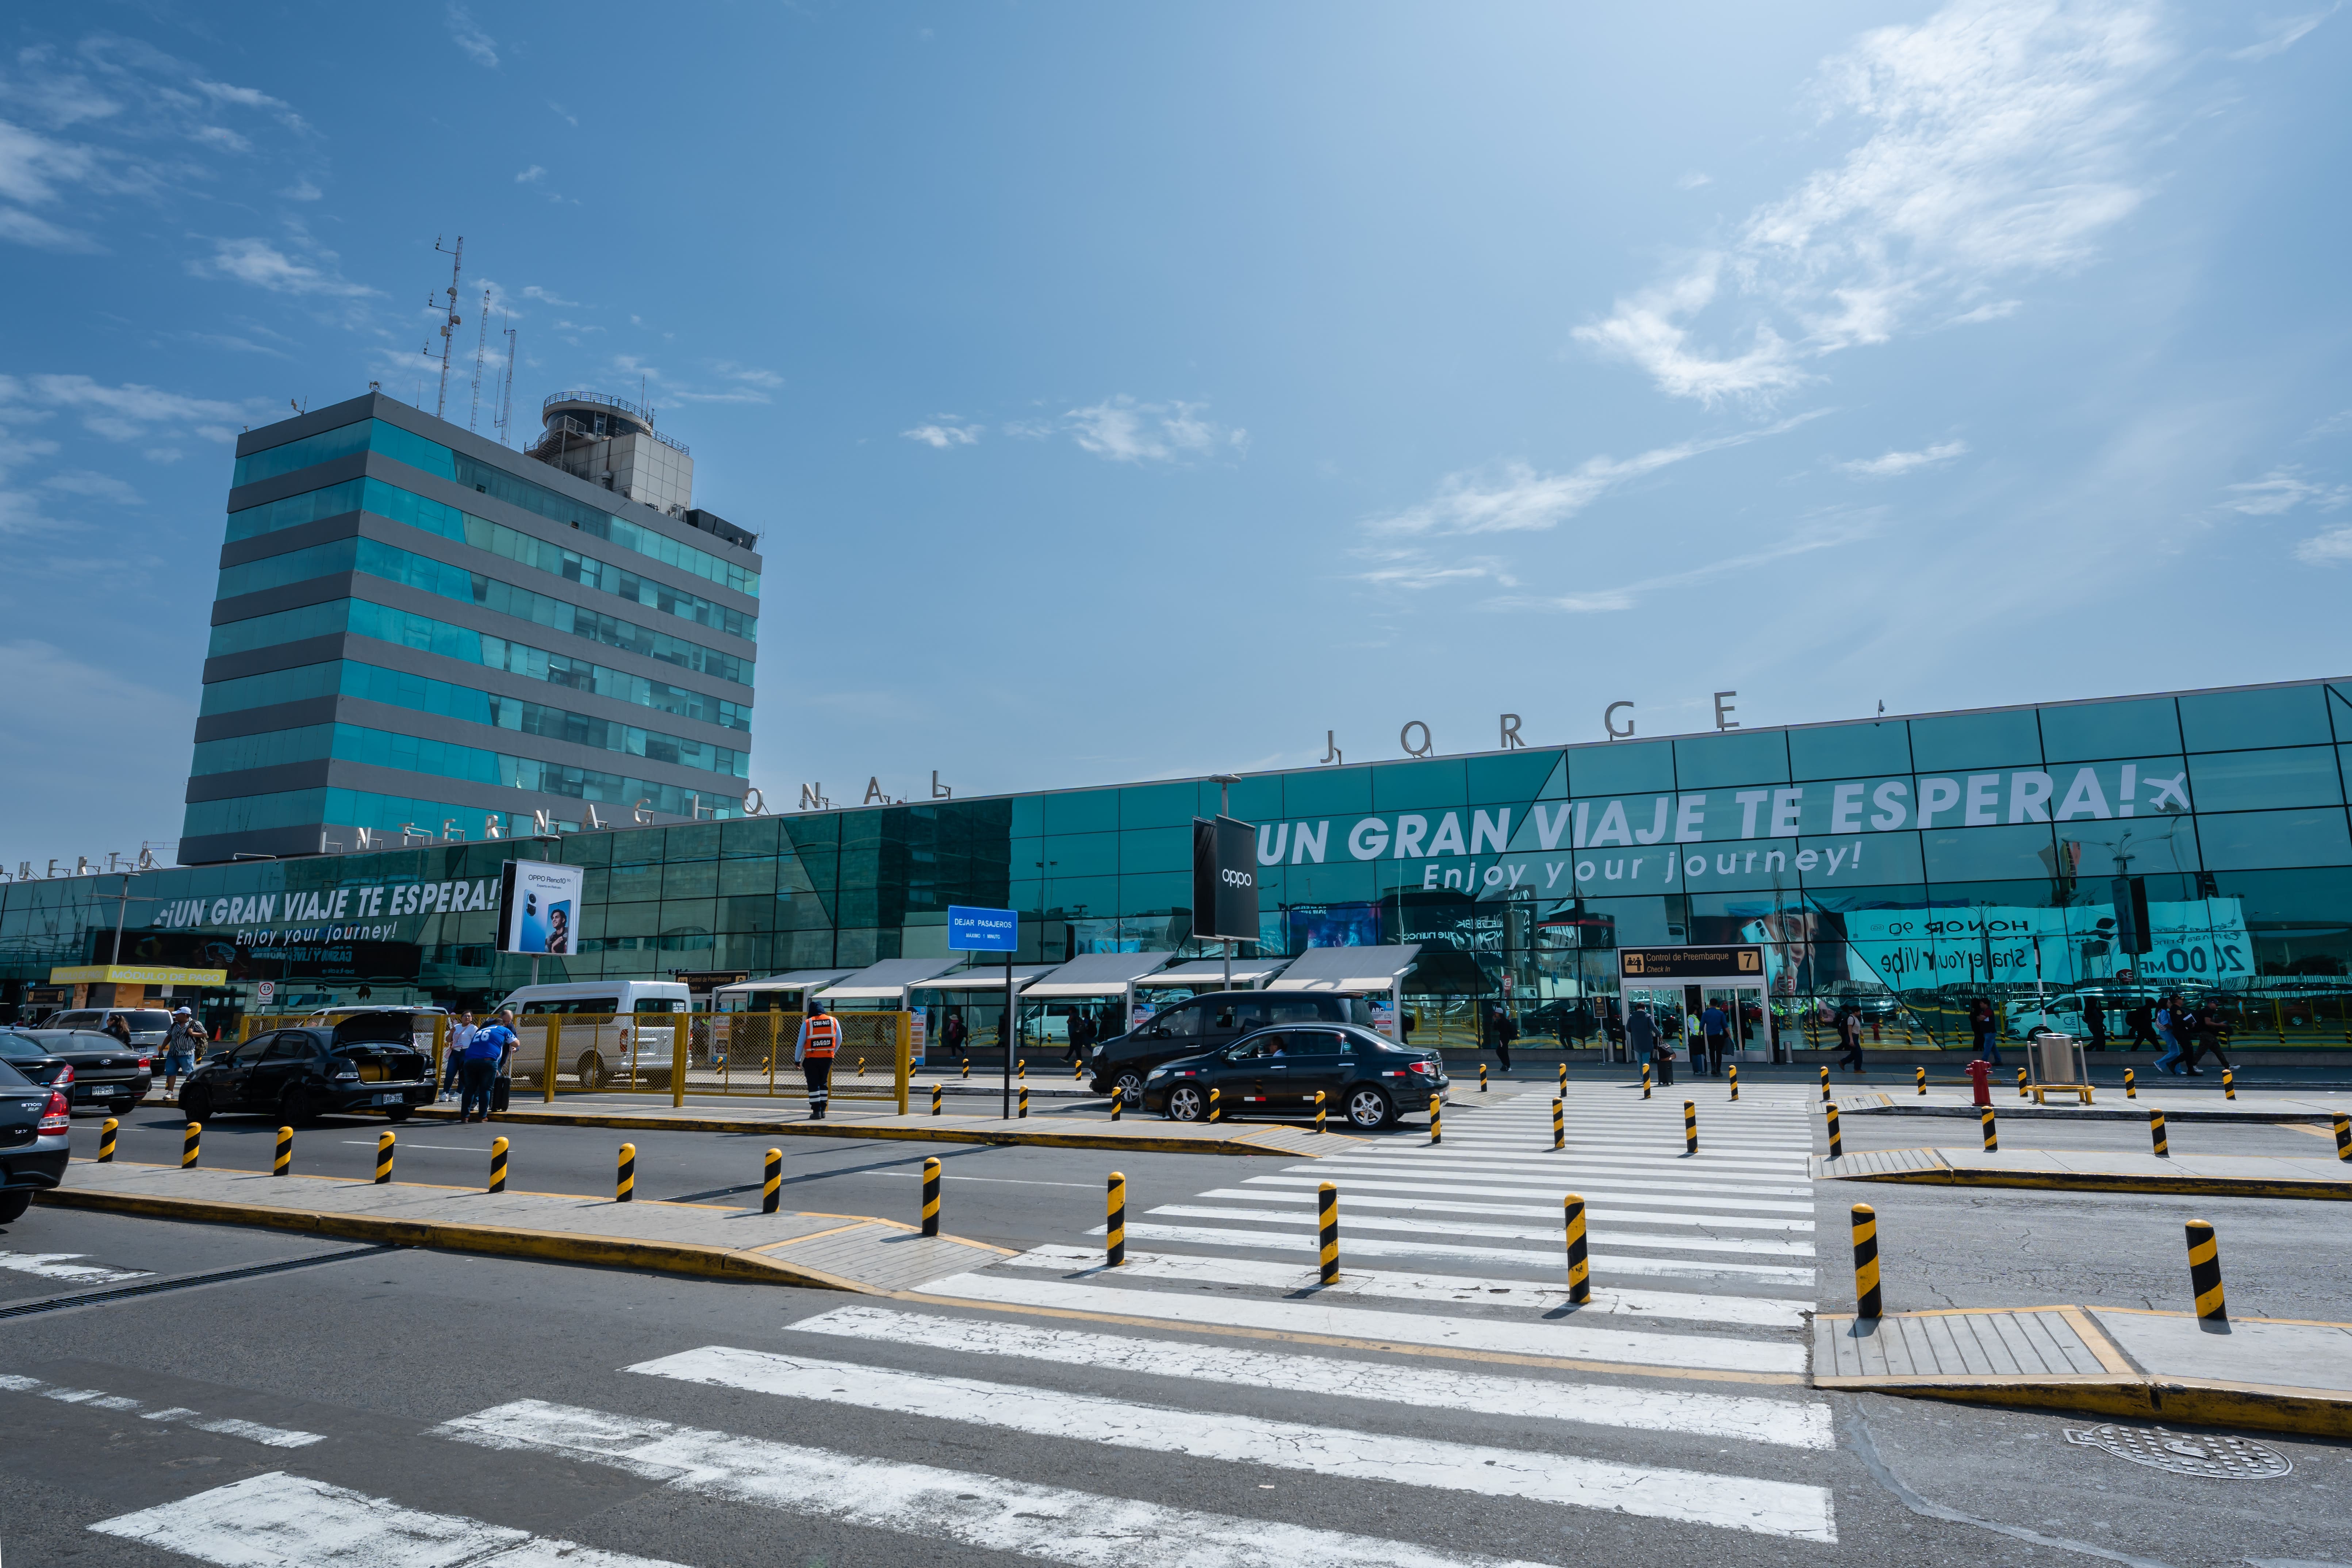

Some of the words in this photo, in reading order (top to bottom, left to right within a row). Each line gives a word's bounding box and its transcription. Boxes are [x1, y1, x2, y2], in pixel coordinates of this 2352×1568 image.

[1320, 690, 1740, 764] JORGE
[319, 770, 947, 853] INTERNACIONAL
[1348, 808, 1511, 860] GRAN
[1534, 794, 1706, 850] VIAJE
[1735, 787, 1803, 839] TE
[1831, 764, 2137, 834] ESPERA!
[0, 848, 152, 880] UERTO
[1223, 869, 1251, 888] oppo
[1424, 863, 1526, 892] Enjoy
[1546, 859, 1642, 889] your
[1665, 841, 1862, 883] journey!
[166, 899, 206, 928] ¡UN
[211, 894, 276, 925] GRAN
[285, 890, 349, 921] VIAJE
[358, 887, 384, 917] TE
[389, 879, 498, 916] ESPERA!
[236, 929, 277, 947] Enjoy
[283, 928, 319, 946] your
[325, 921, 397, 944] journey!
[955, 918, 974, 926] DEJAR
[978, 920, 1012, 928] PASAJEROS
[1646, 952, 1670, 961] Control
[1673, 953, 1681, 961] de
[1683, 952, 1728, 962] Preembarque
[1743, 954, 1752, 968] 7
[112, 969, 166, 981] MÓDULO
[188, 973, 220, 982] PAGO
[473, 1029, 491, 1042] 26
